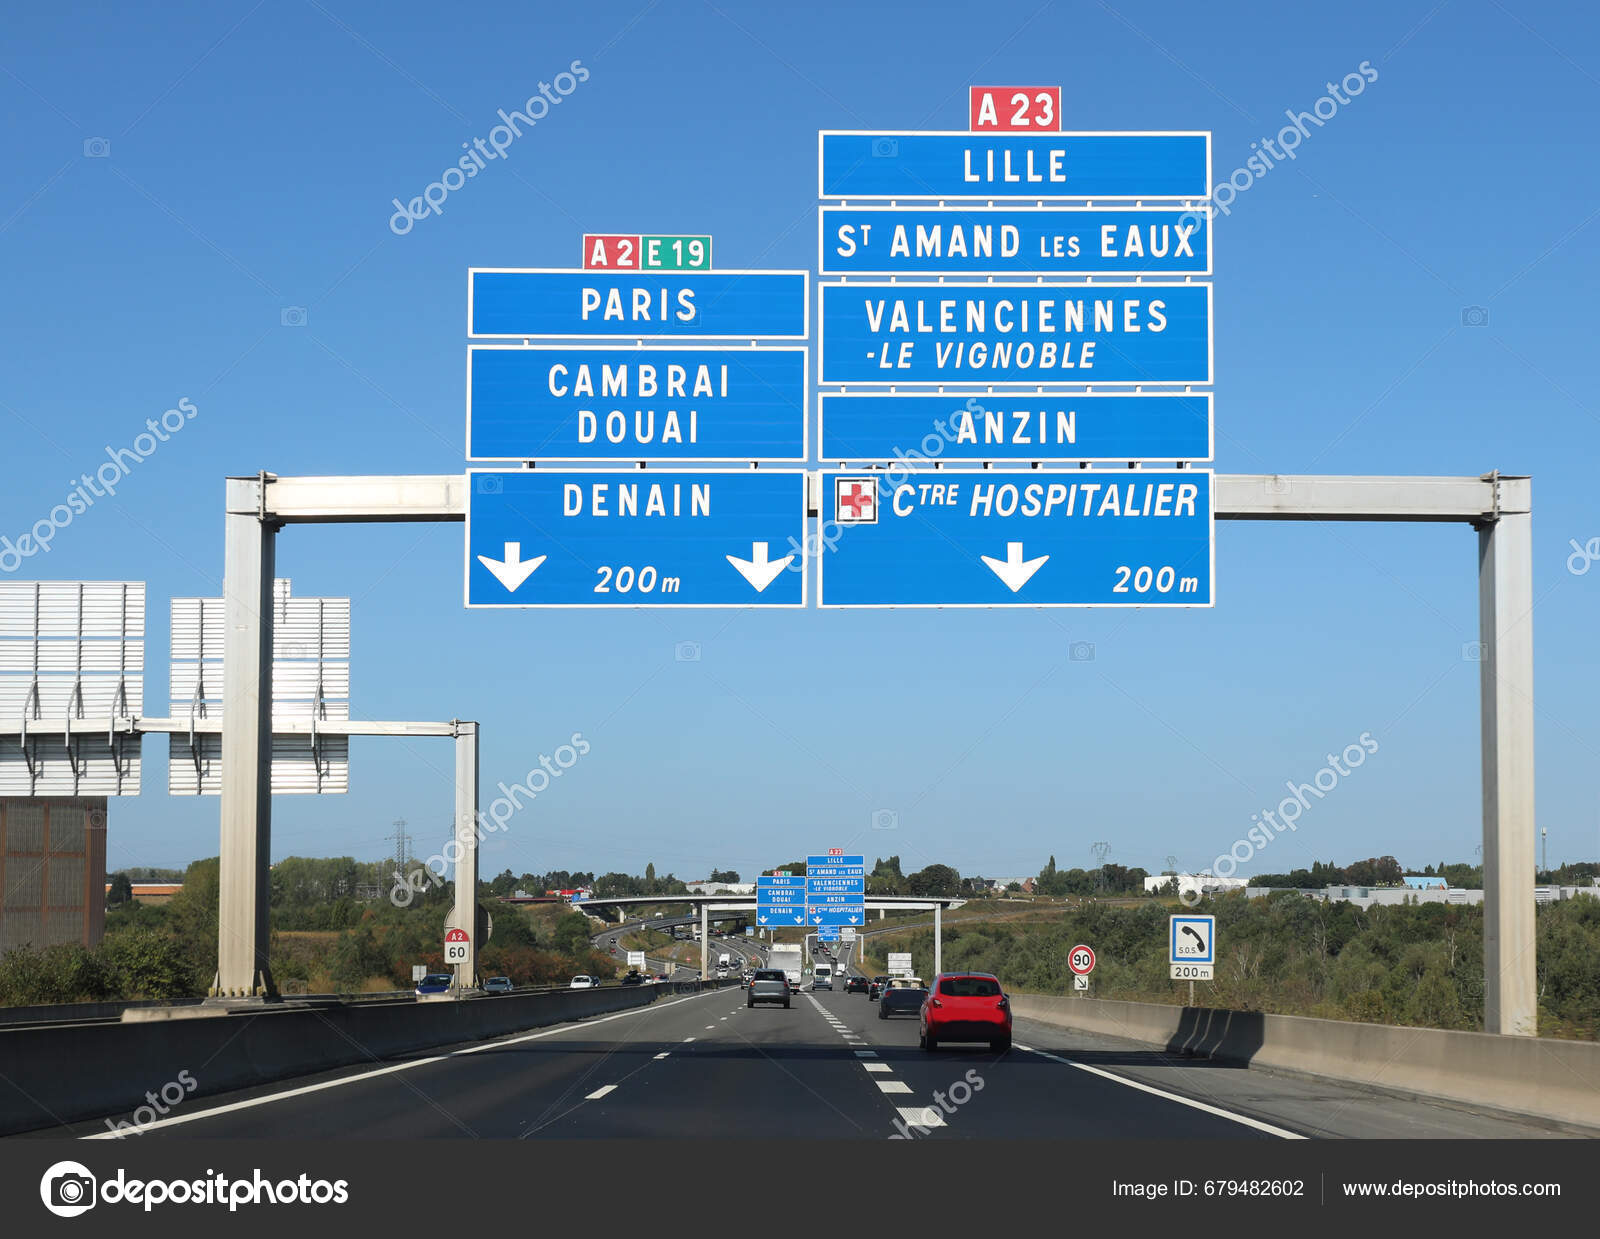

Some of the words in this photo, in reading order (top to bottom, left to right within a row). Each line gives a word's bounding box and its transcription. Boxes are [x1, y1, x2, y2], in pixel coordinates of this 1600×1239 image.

[977, 93, 998, 126] A
[1010, 93, 1054, 126] 23
[964, 149, 1067, 183] LILLE
[590, 239, 608, 266] A
[617, 239, 633, 266] 2
[648, 239, 662, 266] E
[673, 239, 704, 267] 19
[890, 224, 1020, 258] AMAND
[1040, 236, 1081, 258] LES
[1101, 224, 1194, 258] EAUX
[581, 288, 697, 321] PARIS
[865, 300, 1167, 333] VALENCIENNES
[935, 342, 1096, 369] VIGNOBLE
[548, 364, 728, 398] CAMBRAI
[578, 410, 697, 444] DOUAI
[957, 411, 1076, 444] ANZIN
[563, 484, 710, 517] DENAIN
[892, 483, 959, 518] CTRE
[970, 483, 1198, 518] HOSPITALIER
[594, 565, 657, 593] 200
[661, 577, 680, 593] m
[1112, 565, 1175, 593] 200
[1179, 577, 1198, 593] m
[449, 947, 465, 958] 60
[1073, 954, 1090, 966] 90
[1175, 967, 1198, 978] 200
[1200, 970, 1209, 978] m
